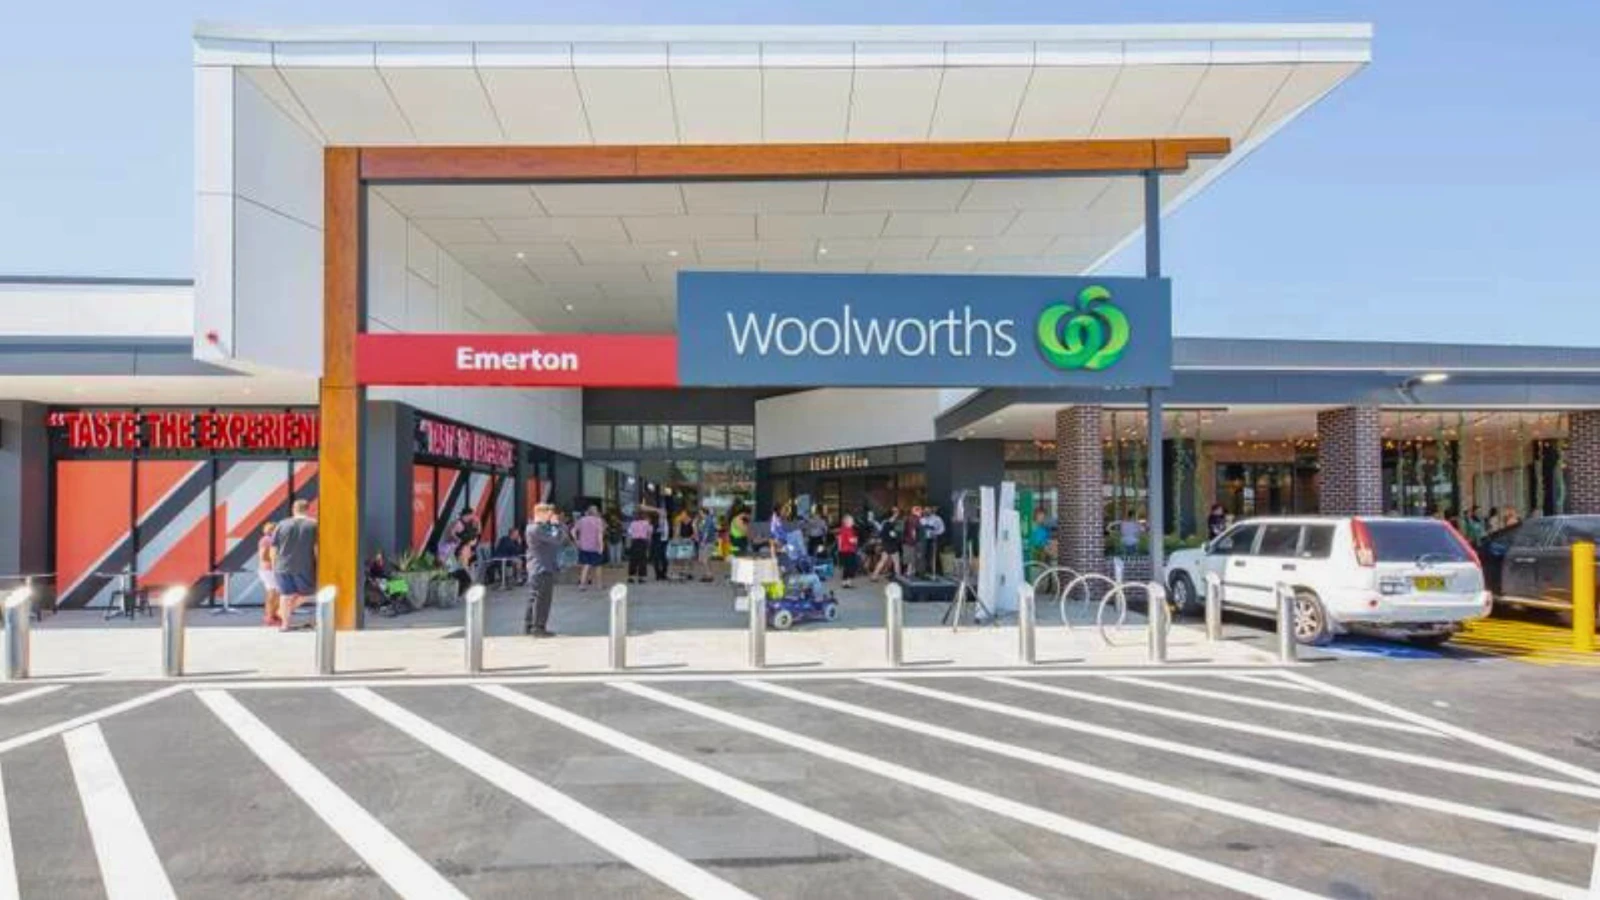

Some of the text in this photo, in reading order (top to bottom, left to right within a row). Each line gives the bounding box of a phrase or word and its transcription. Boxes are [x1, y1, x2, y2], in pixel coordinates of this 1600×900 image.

[727, 305, 1017, 357] Woolworths
[456, 347, 579, 371] Emerton
[149, 412, 196, 448] THE
[200, 412, 319, 449] EXPERIEN
